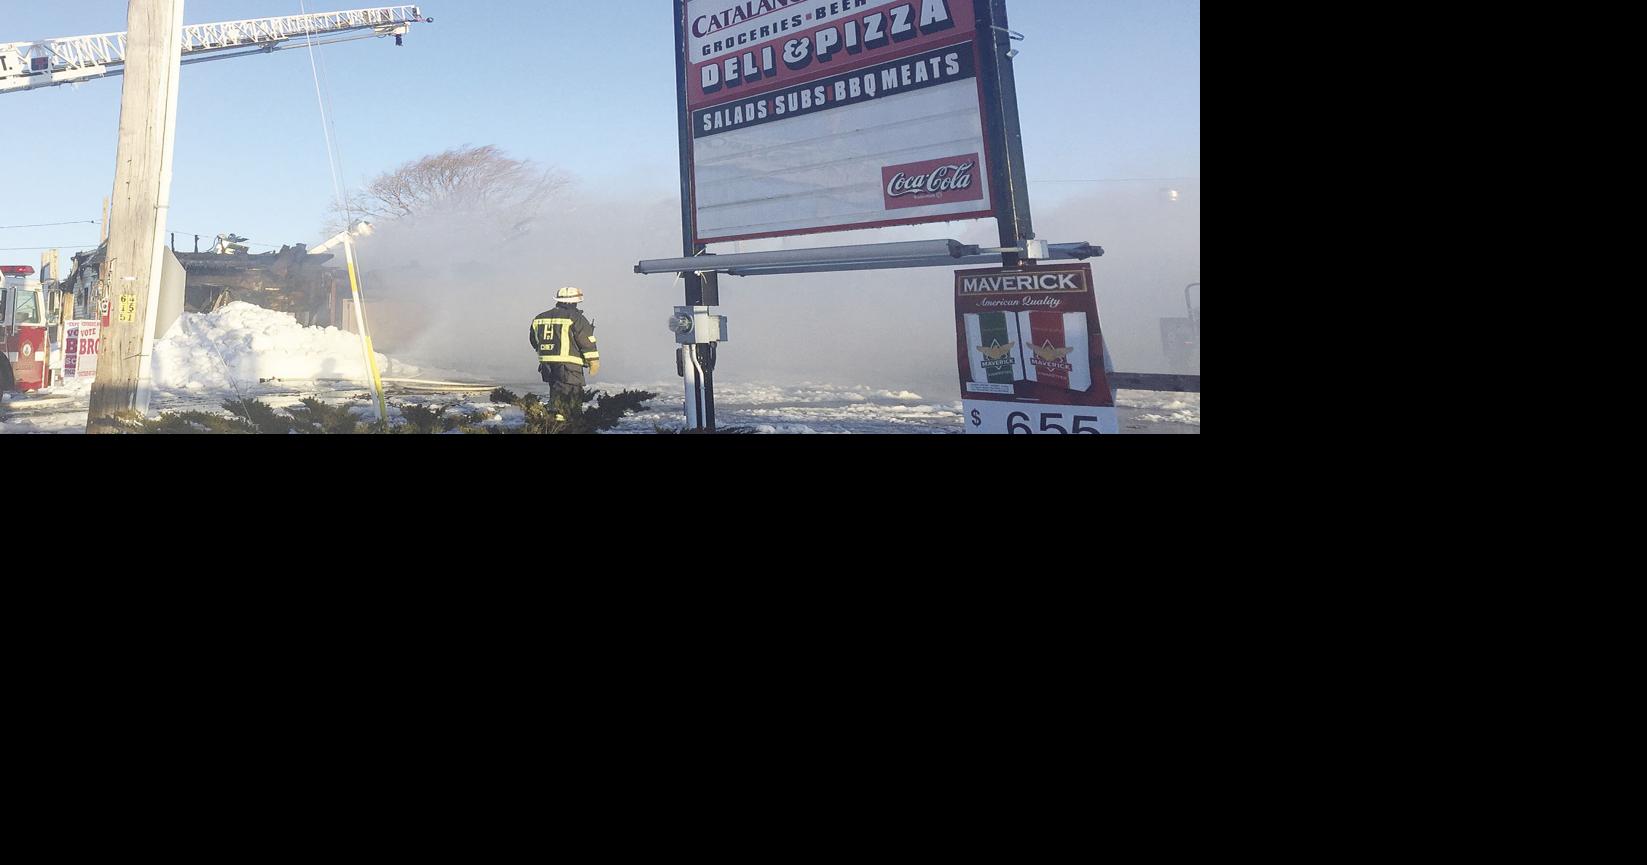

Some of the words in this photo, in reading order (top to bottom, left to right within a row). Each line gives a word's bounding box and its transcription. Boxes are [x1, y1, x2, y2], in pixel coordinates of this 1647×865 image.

[702, 14, 803, 56] GROCERIES
[701, 46, 776, 92] DELI
[783, 37, 812, 68] &
[814, 0, 953, 60] PIZZA
[703, 100, 767, 131] SALADS
[775, 86, 826, 115] SUBS
[834, 73, 877, 101] BBQ
[881, 52, 960, 90] MEATS
[963, 274, 1078, 292] MAVERICK
[976, 297, 1019, 307] American
[1022, 295, 1061, 308] Quality
[80, 328, 96, 337] VOTE
[982, 359, 1014, 367] MAVERICK
[1031, 358, 1071, 371] MAVERICK
[971, 408, 982, 427] $
